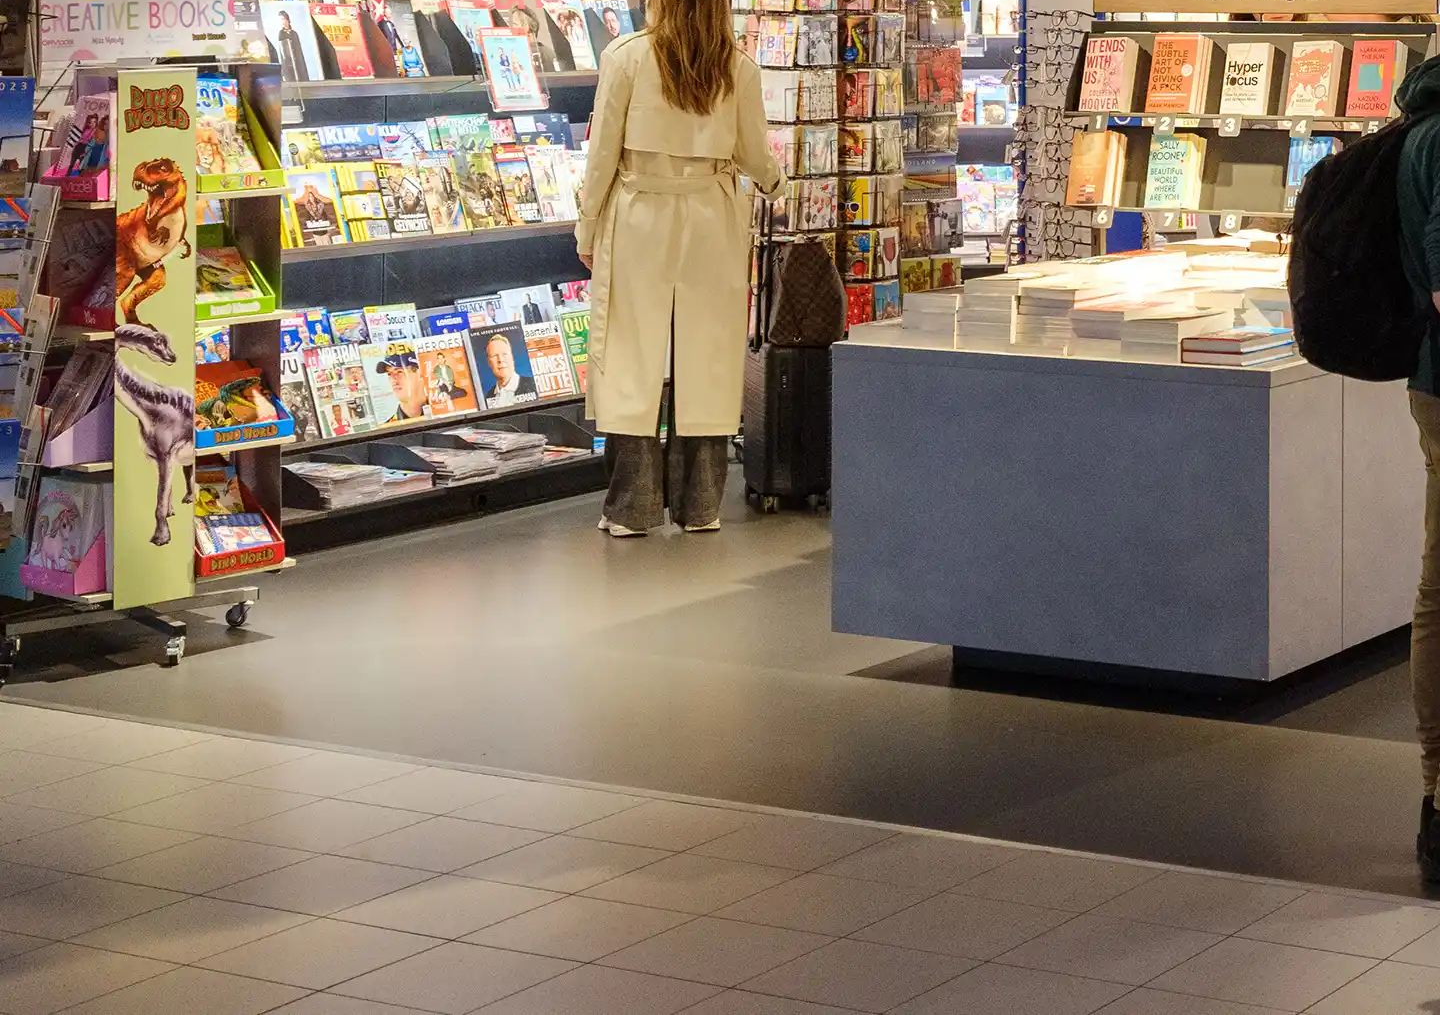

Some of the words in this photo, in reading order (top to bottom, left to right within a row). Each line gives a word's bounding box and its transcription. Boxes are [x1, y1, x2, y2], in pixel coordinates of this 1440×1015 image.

[40, 1, 140, 33] CREATIVE
[149, 0, 227, 29] BOOKS
[1087, 40, 1098, 54] IT
[1100, 39, 1126, 53] ENDS
[1157, 42, 1173, 50] THE
[1155, 50, 1189, 58] SUBTLE
[1087, 55, 1112, 69] WITH
[1154, 58, 1173, 66] ART
[1175, 58, 1187, 66] OF
[1227, 60, 1263, 76] Hyper
[1084, 71, 1097, 84] US
[1153, 67, 1172, 75] NOT
[1152, 75, 1183, 83] GIVING
[1226, 74, 1258, 86] focus
[130, 84, 184, 111] DINO
[1081, 98, 1119, 110] HOOVER
[1348, 102, 1387, 110] ISHIGURO
[125, 104, 190, 133] WORLD
[1096, 115, 1102, 129] 1
[1158, 116, 1171, 131] 2
[1224, 118, 1236, 132] 3
[1294, 119, 1307, 133] 4
[1367, 121, 1380, 134] 5
[1160, 141, 1180, 150] SALLY
[1152, 151, 1186, 161] ROONEY
[1150, 167, 1184, 176] BEAUTIFUL
[1154, 185, 1176, 193] WHERE
[1149, 194, 1161, 202] ARE
[1096, 210, 1108, 223] 6
[1163, 213, 1174, 227] 7
[1224, 214, 1237, 229] 8
[416, 338, 462, 353] HEROES
[243, 424, 279, 440] WORLD
[211, 555, 237, 571] DINO
[241, 548, 274, 564] WORLD
